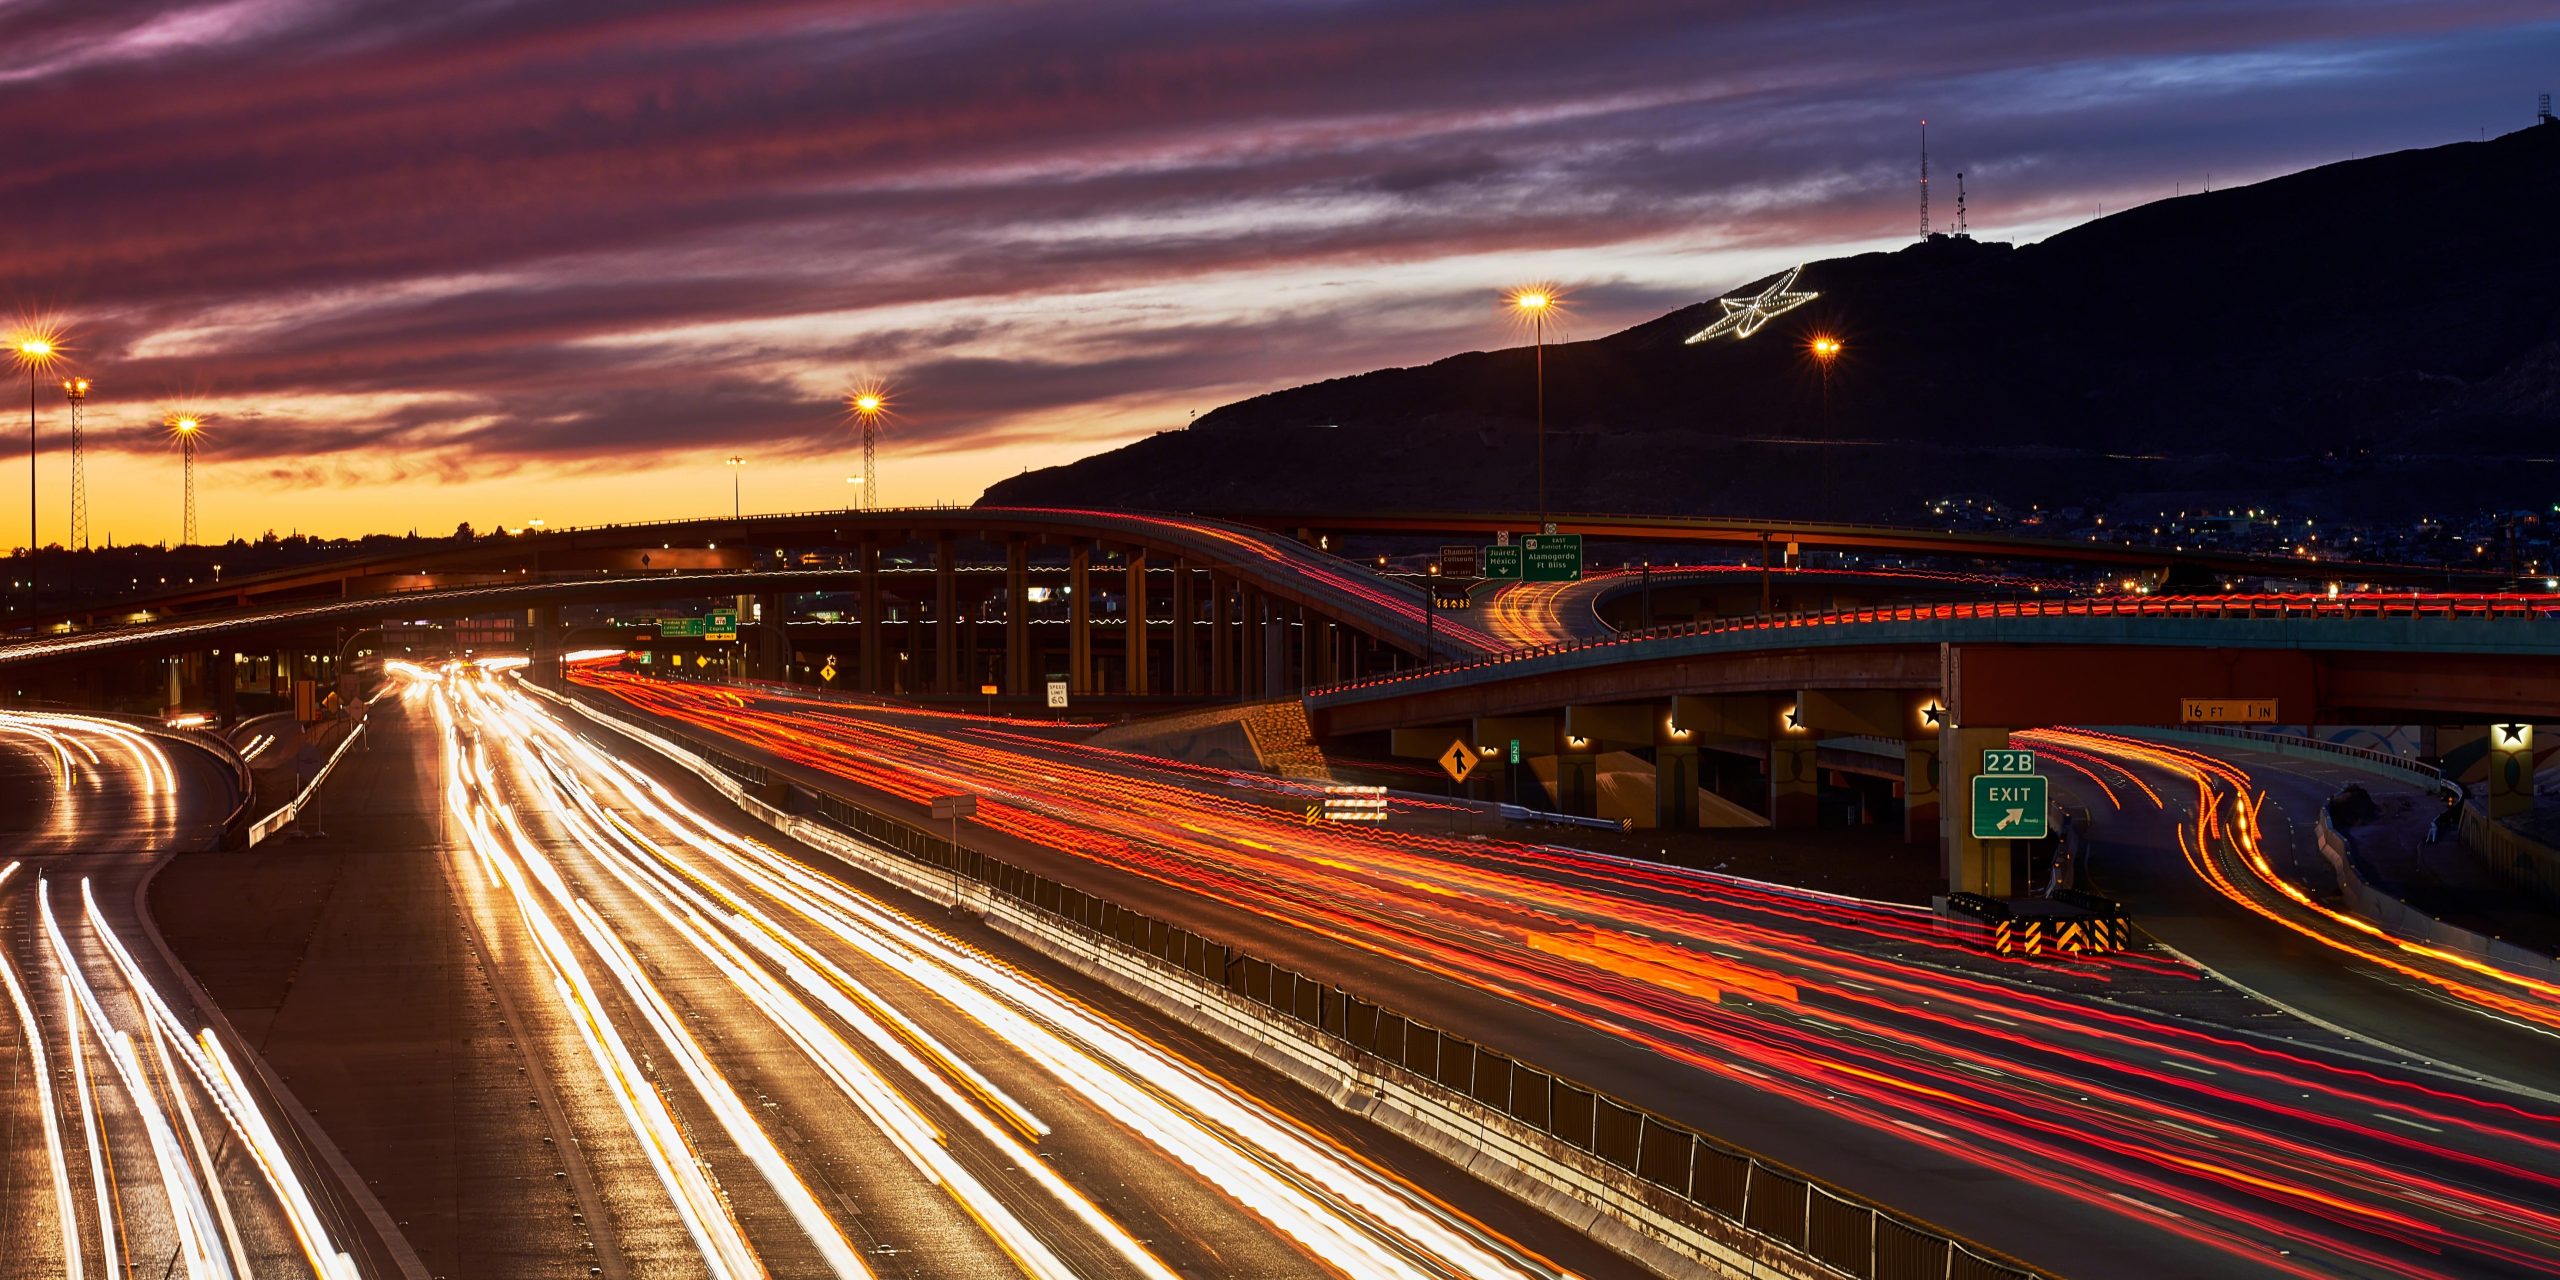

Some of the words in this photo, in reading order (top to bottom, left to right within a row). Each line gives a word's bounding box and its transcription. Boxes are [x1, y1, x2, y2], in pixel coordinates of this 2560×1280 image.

[1528, 553, 1575, 561] Alamogordo
[1052, 696, 1064, 704] 60
[2189, 704, 2202, 717] 16
[2210, 707, 2223, 717] FT
[2248, 704, 2252, 717] 1
[2260, 707, 2271, 717] IN
[1987, 754, 2032, 771] 22B
[1989, 787, 2031, 802] EXIT
